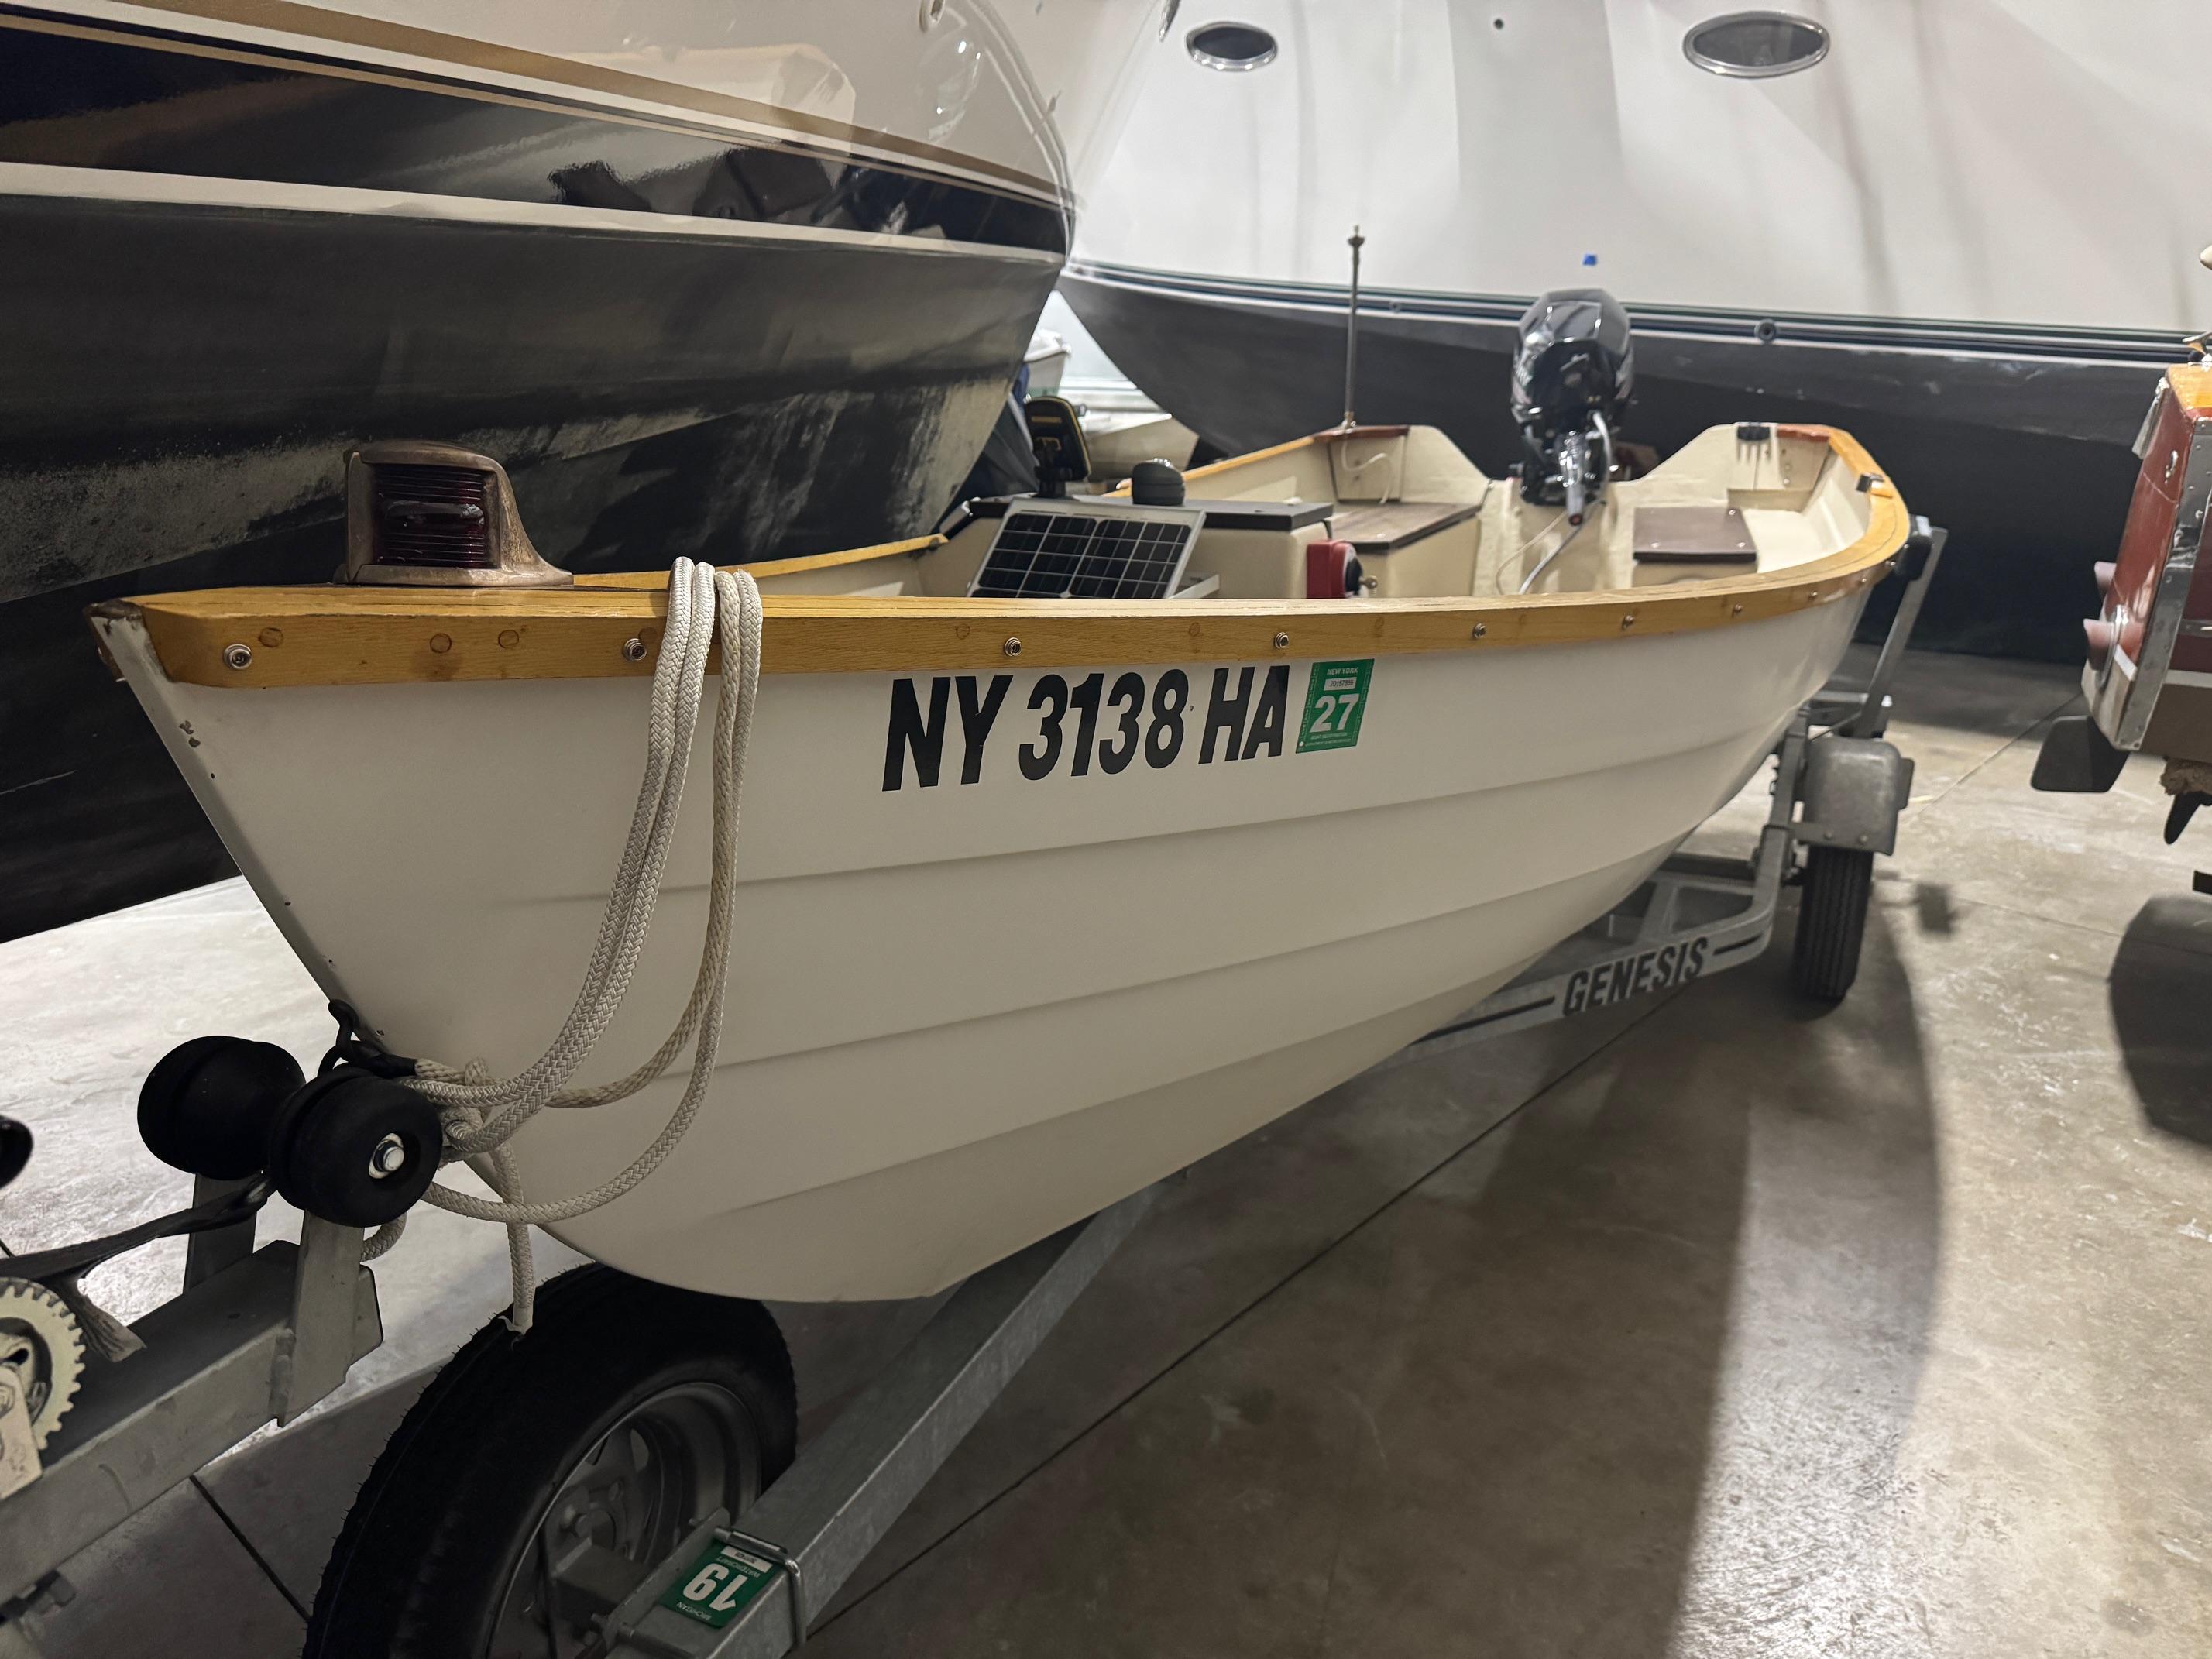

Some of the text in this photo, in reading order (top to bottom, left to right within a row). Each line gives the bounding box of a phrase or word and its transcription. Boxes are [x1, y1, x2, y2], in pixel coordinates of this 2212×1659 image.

[881, 665, 1290, 792] NY 3138 HA
[1310, 694, 1359, 732] 27
[1562, 936, 1709, 1017] GENESIS
[682, 1562, 749, 1612] 19
[716, 1556, 761, 1578] WATERCRAFT
[675, 1601, 712, 1620] MICHIGAN
